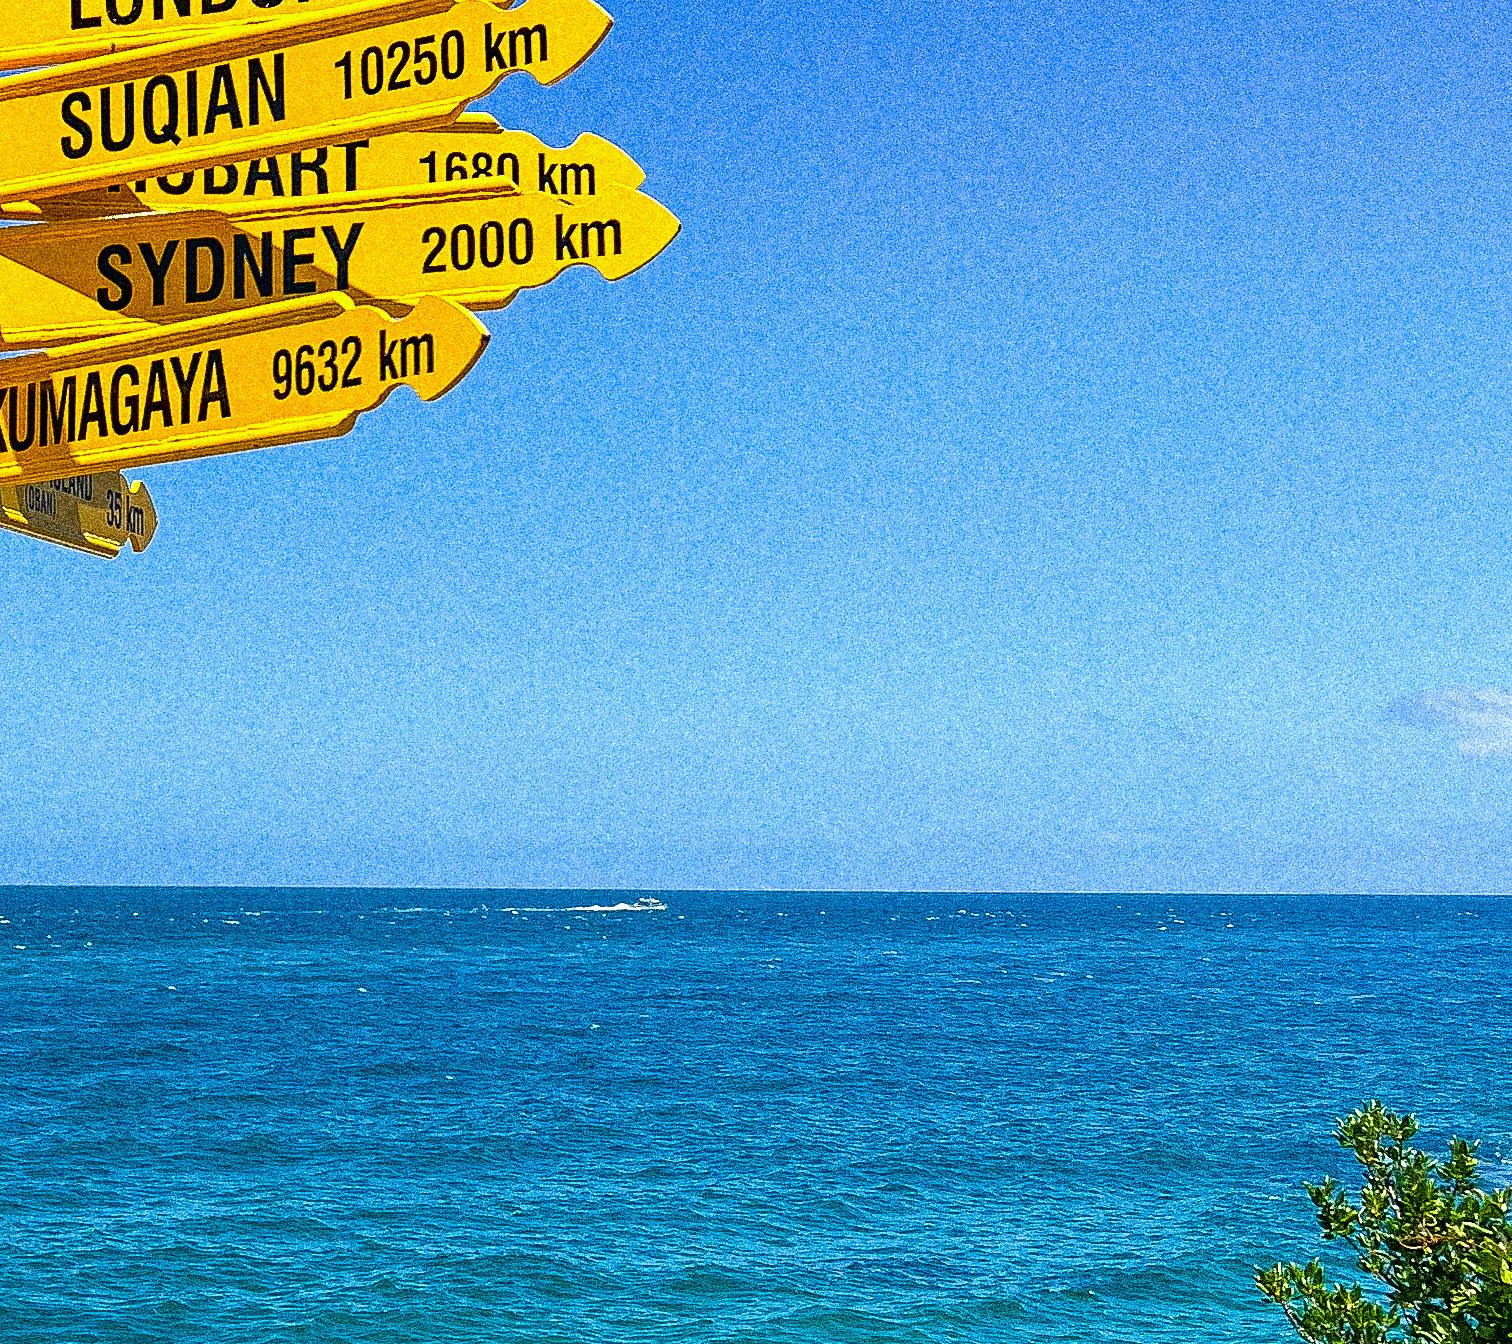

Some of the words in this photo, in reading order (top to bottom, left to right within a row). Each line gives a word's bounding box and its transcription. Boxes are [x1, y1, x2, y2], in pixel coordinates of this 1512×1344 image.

[59, 53, 286, 160] SUQIAN
[334, 29, 466, 100] 10250
[484, 23, 549, 73] km
[108, 141, 370, 197] OBART
[538, 152, 597, 197] km
[95, 222, 366, 312] SYDNEY
[421, 218, 534, 274] 2000
[555, 213, 623, 262] km
[272, 335, 362, 400] 9632
[378, 329, 435, 382] km
[105, 490, 122, 529] 35
[125, 495, 144, 536] km
